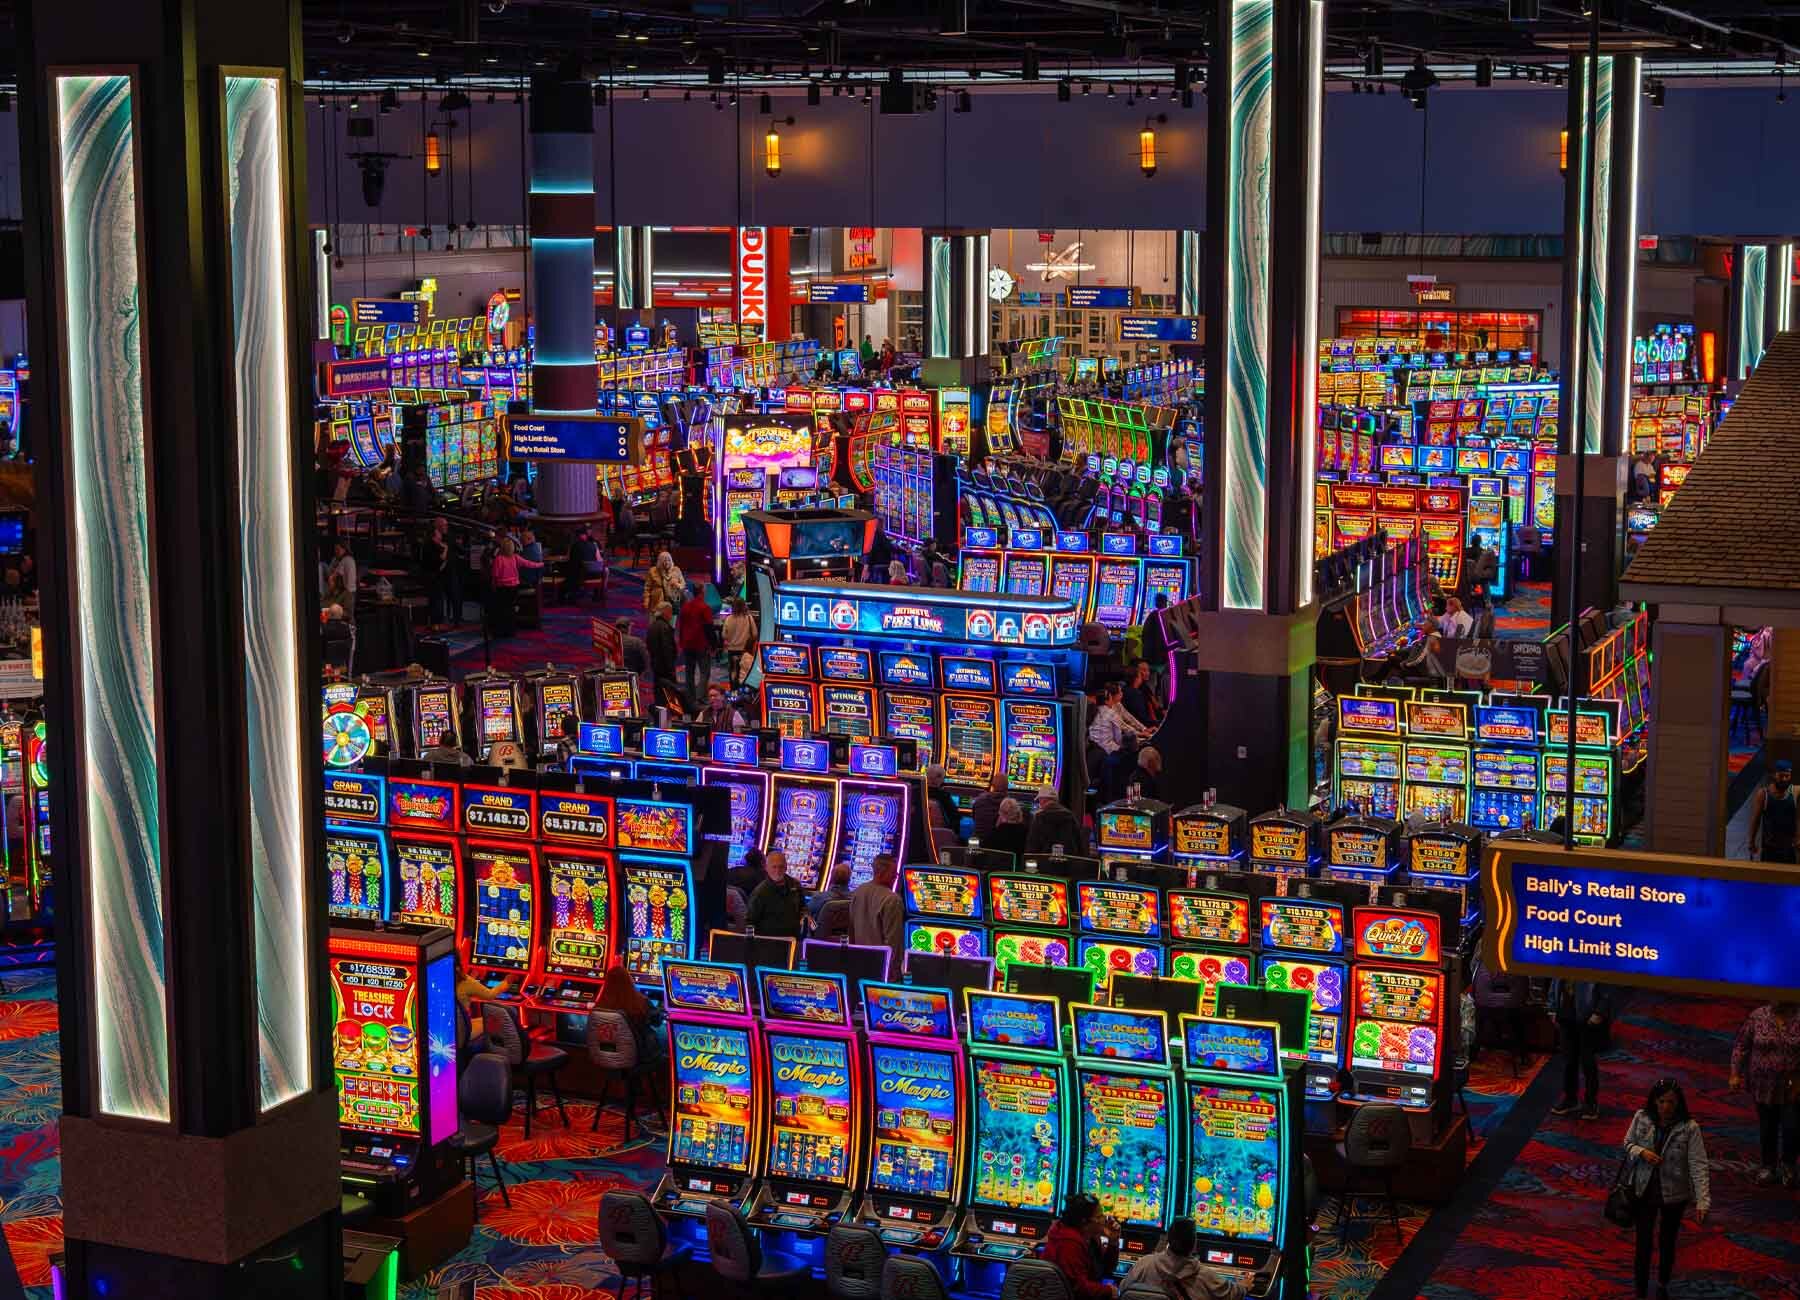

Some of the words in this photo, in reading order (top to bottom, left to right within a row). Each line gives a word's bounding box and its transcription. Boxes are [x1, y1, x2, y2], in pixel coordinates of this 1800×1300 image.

[882, 614, 912, 629] FIRE
[914, 615, 944, 633] LINK
[772, 688, 805, 697] WINNER
[831, 693, 864, 701] WINNER
[840, 705, 856, 713] 270
[333, 780, 362, 792] GRAND
[482, 795, 513, 807] GRAND
[559, 802, 590, 814] GRAND
[1526, 877, 1582, 897] Bally's
[1587, 882, 1635, 900] Retail
[1640, 886, 1686, 904] Store
[1526, 905, 1569, 923] Food
[1574, 910, 1622, 928] Court
[1366, 926, 1401, 942] Quick
[1402, 930, 1426, 945] Hit
[1524, 934, 1563, 954] High
[1568, 938, 1611, 956] Limit
[1615, 943, 1659, 961] Slots
[352, 990, 395, 1004] TREASURE
[353, 1002, 394, 1019] LOCK
[882, 1011, 934, 1028] Magic
[676, 1031, 746, 1057] OCEAN
[680, 1053, 747, 1075] Magic
[774, 1043, 845, 1068] OCEAN
[777, 1065, 845, 1087] Magic
[878, 1055, 951, 1082] OCEAN
[881, 1077, 951, 1100] Magic
